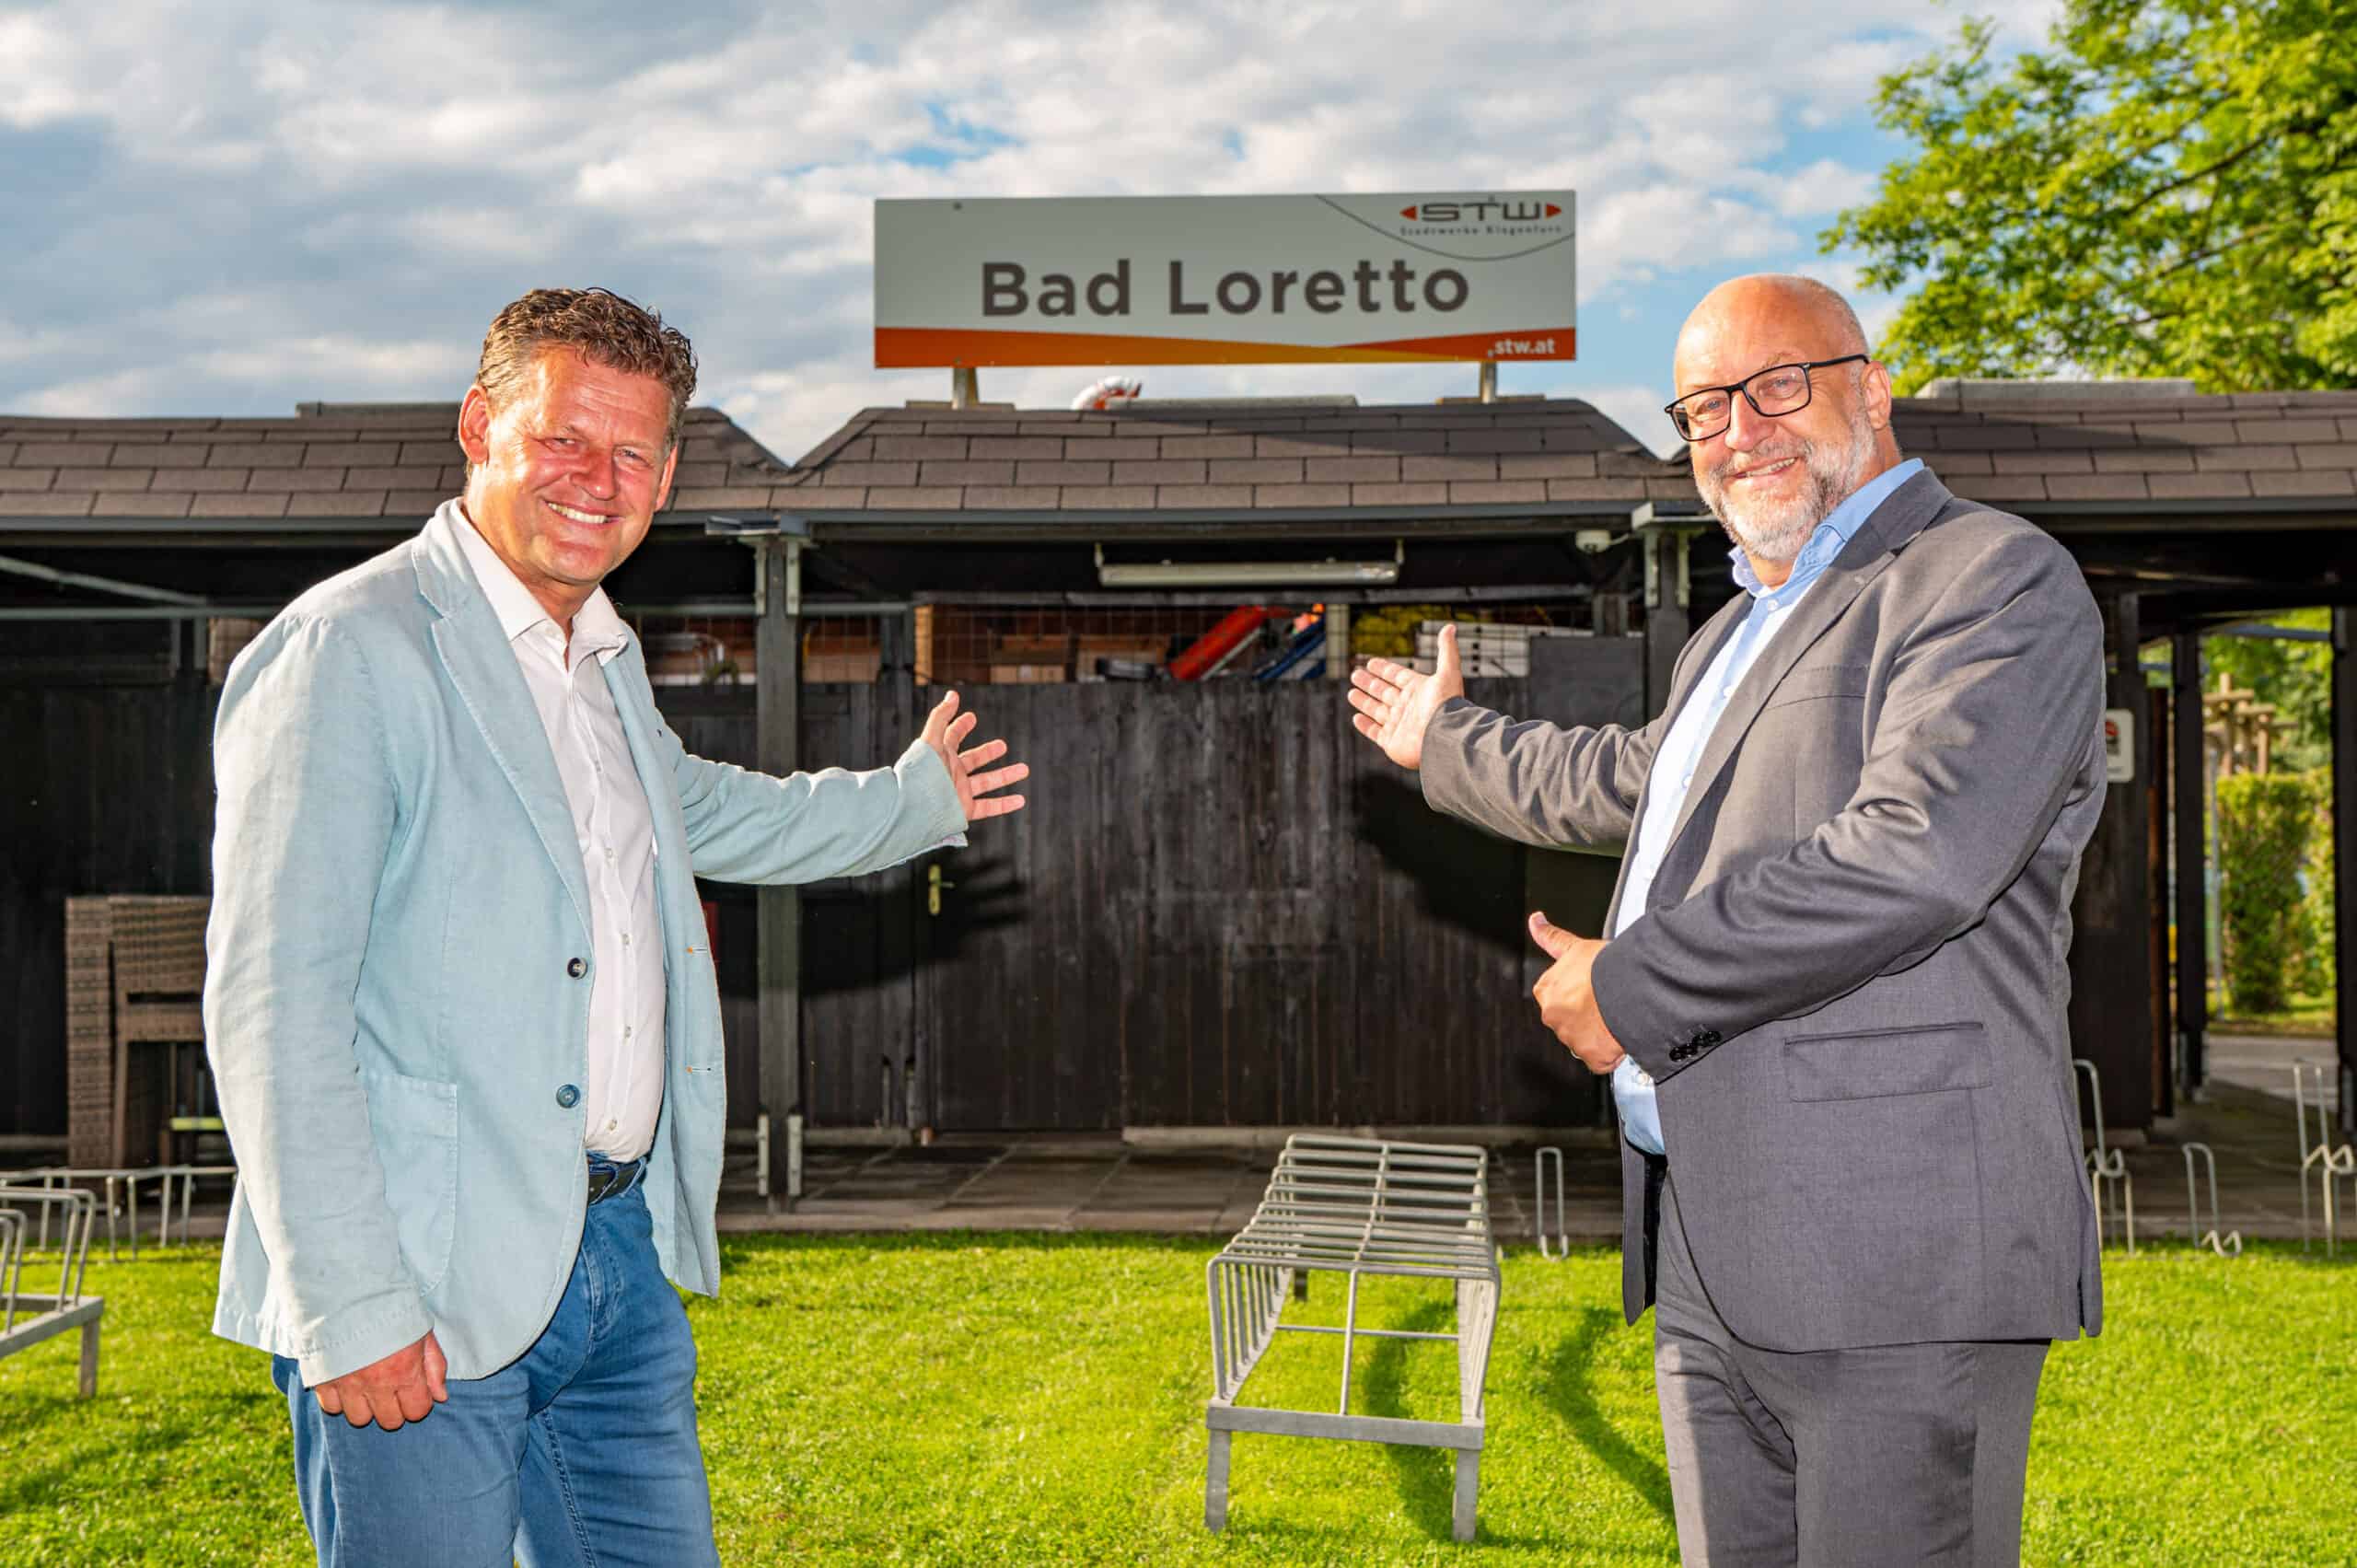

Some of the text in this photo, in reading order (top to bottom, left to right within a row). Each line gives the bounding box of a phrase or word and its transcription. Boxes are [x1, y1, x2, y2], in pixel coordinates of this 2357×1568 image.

[1421, 201, 1541, 223] STW
[981, 258, 1469, 317] Bad Loretto
